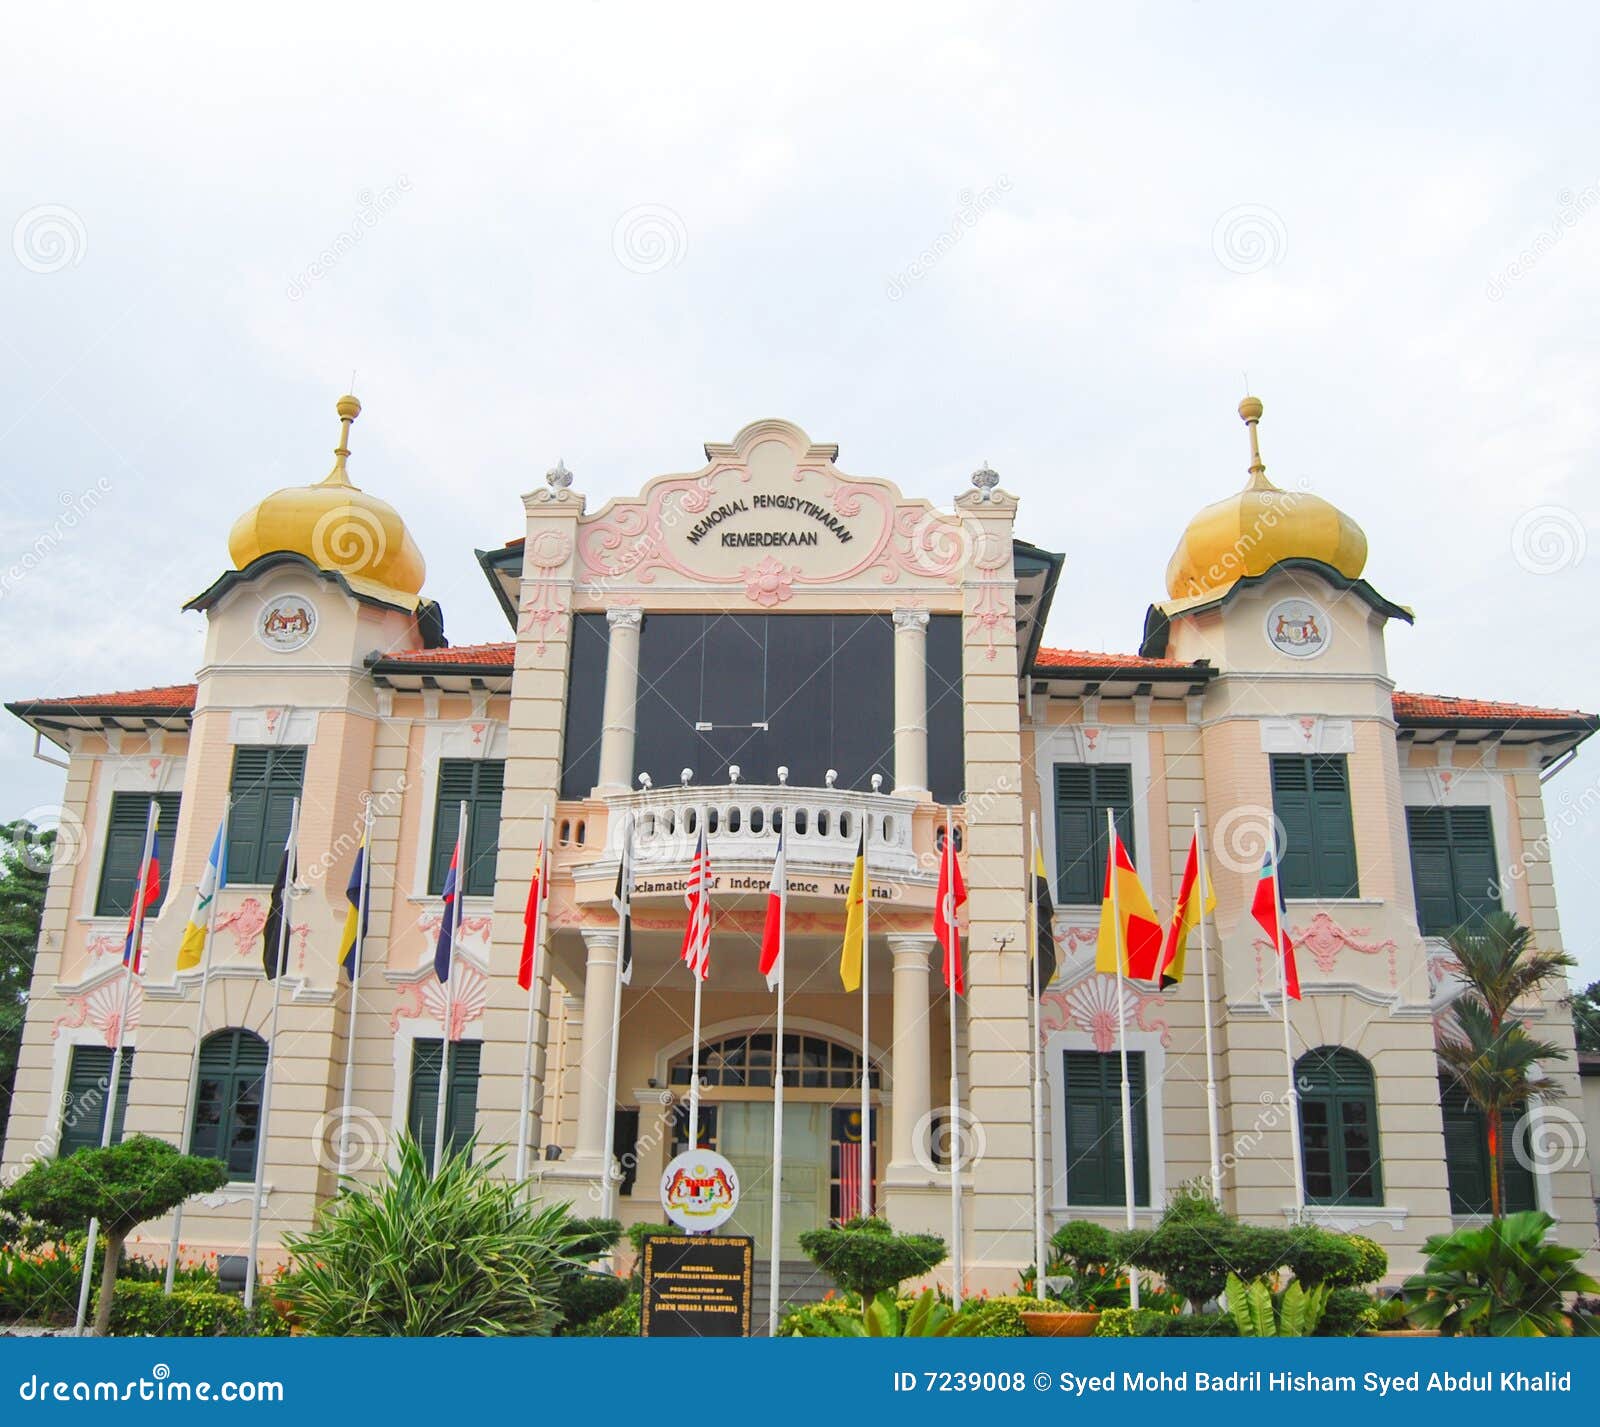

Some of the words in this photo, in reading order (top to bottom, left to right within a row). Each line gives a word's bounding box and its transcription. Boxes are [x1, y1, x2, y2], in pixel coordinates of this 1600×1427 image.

[686, 498, 749, 546] MEMORIAL
[753, 494, 853, 545] PENGISYTIHARAN
[721, 531, 818, 548] KEMERDEKAAN
[730, 877, 819, 893] Indepeence
[833, 883, 893, 899] Merial
